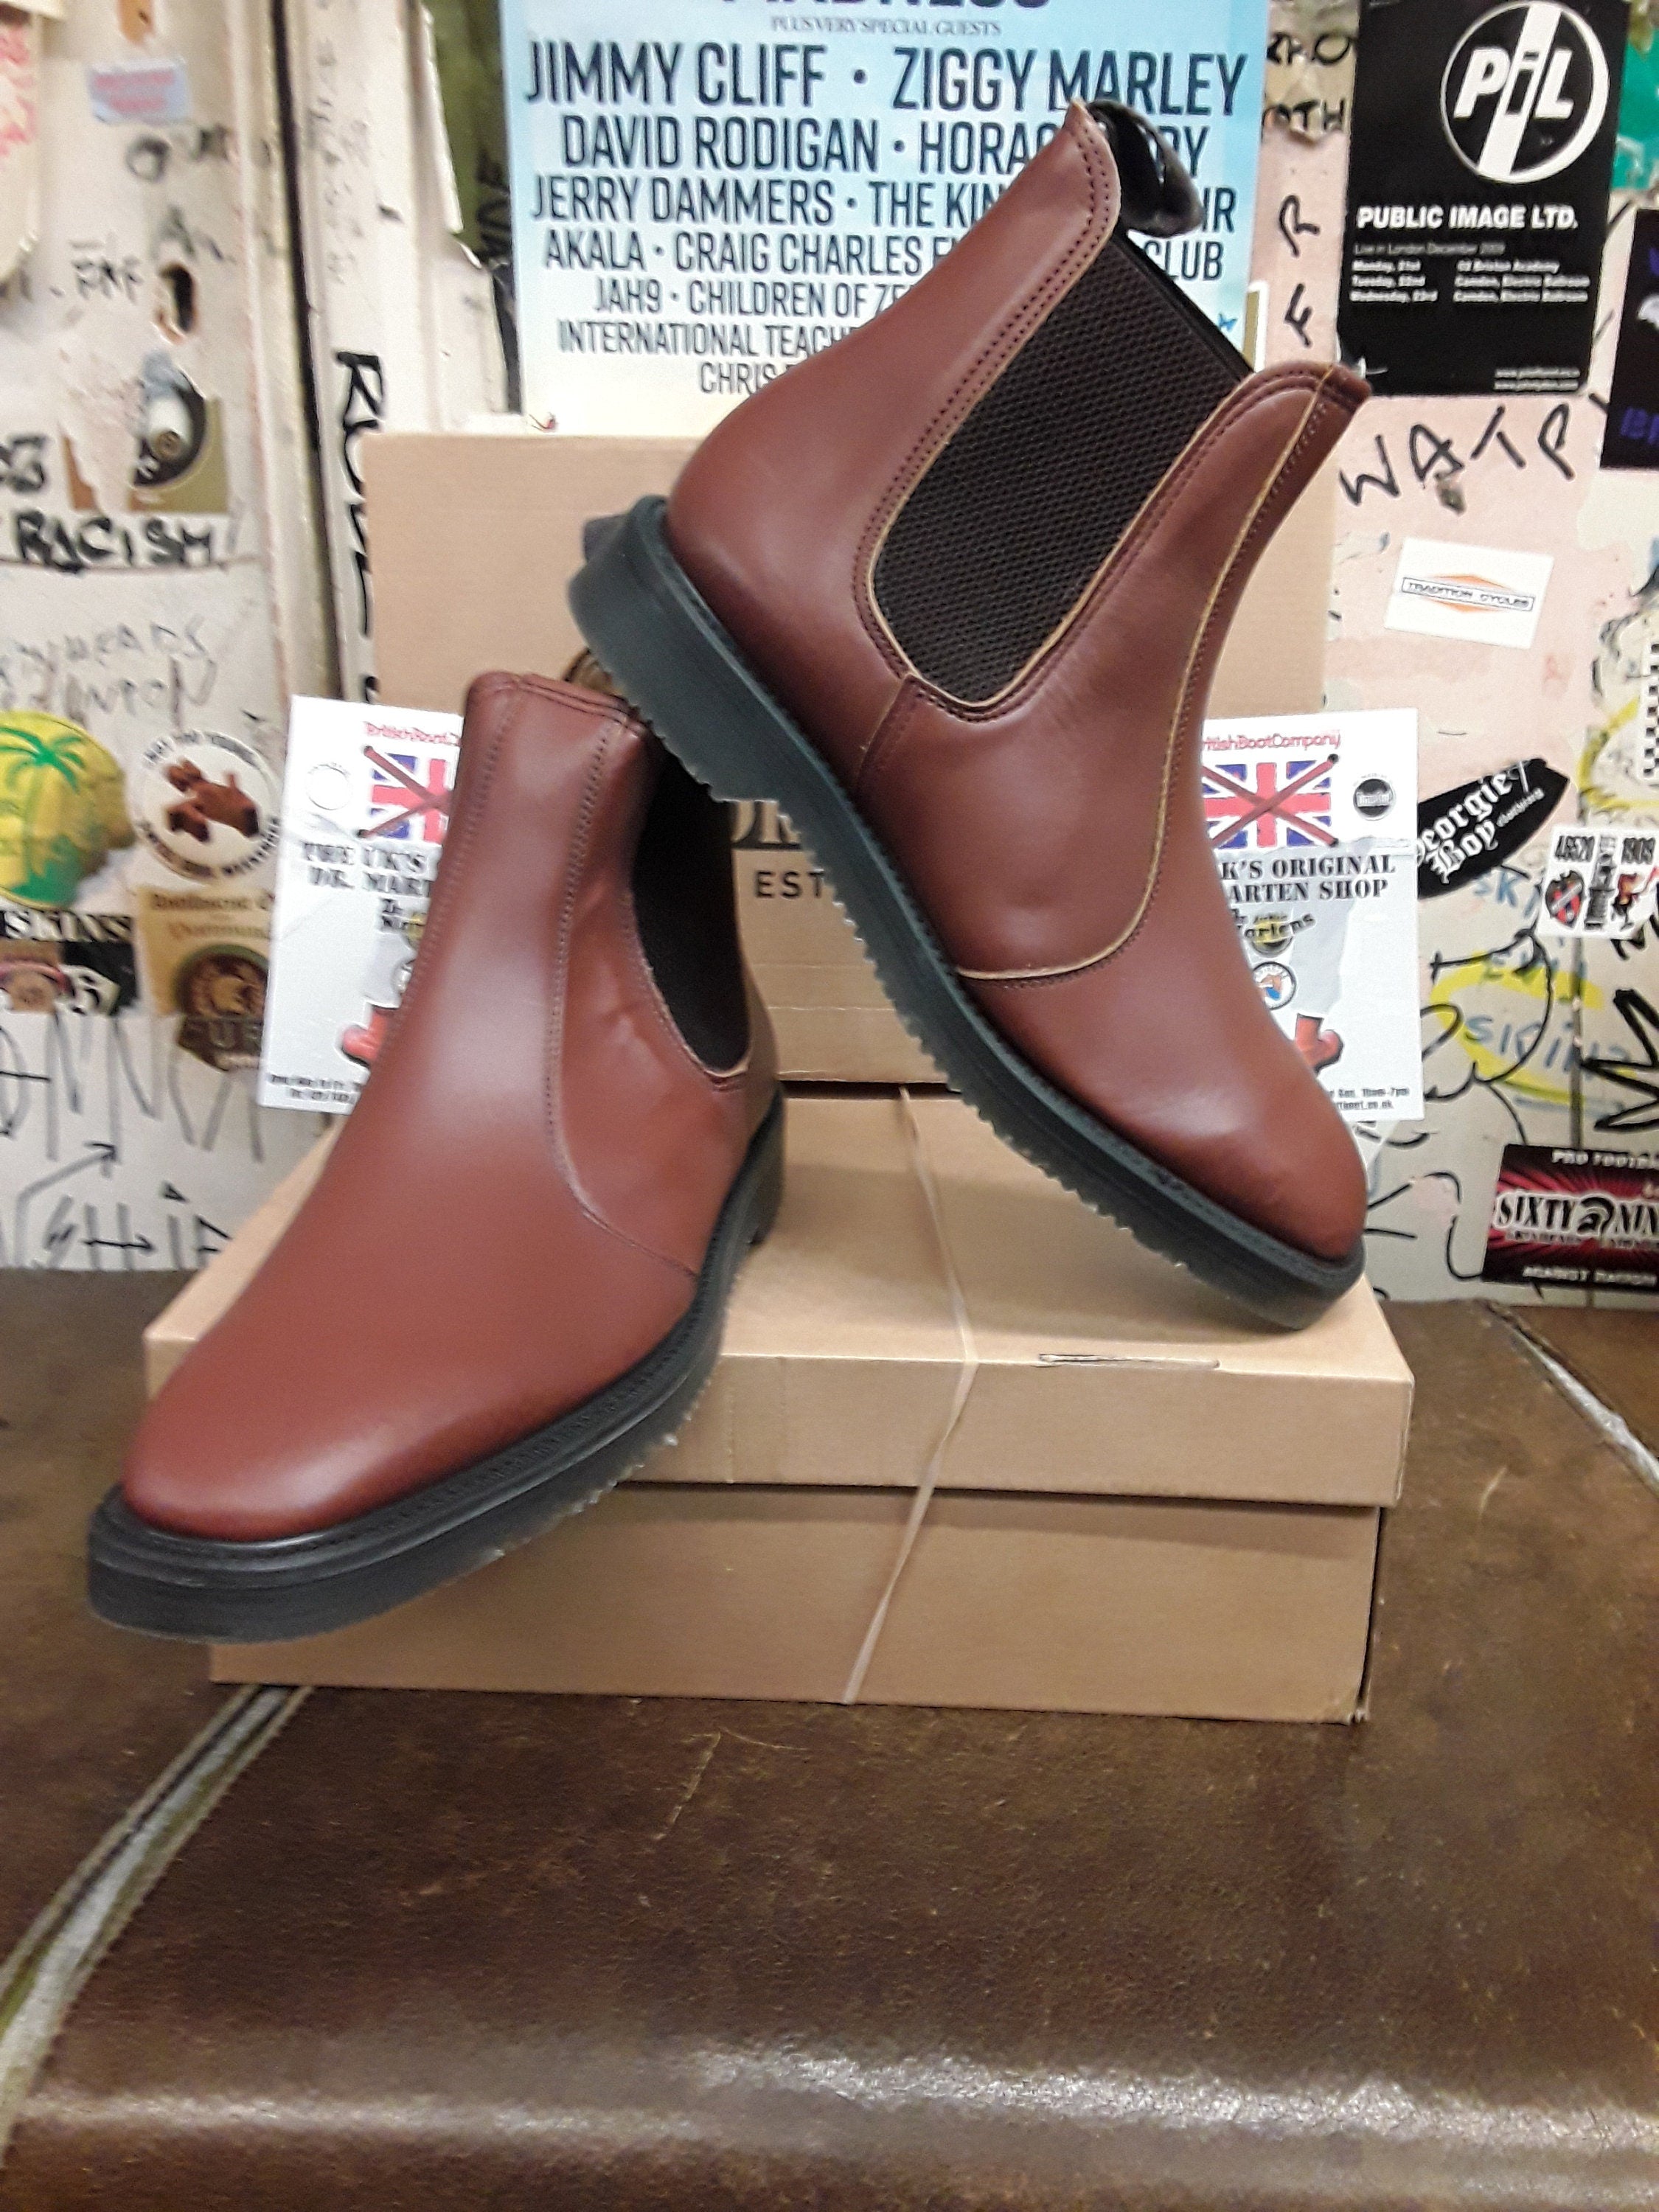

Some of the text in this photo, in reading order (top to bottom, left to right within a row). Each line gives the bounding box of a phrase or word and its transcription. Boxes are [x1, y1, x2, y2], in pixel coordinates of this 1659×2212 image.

[526, 41, 1248, 116] JIMMY CLIFF ZIGGY MARLEY
[563, 114, 680, 169] DAVID
[696, 116, 878, 172] RODIGAN
[534, 175, 1003, 229] JERRY DAMMERS THE KIN
[1357, 204, 1579, 229] PUBLIC IMAGE LTD.
[546, 229, 645, 271] AKALA
[675, 231, 770, 273] CRAIG
[780, 234, 922, 276] CHARLES
[595, 278, 661, 313] JAH9
[689, 279, 826, 318] CHILDREN
[835, 282, 868, 318] OF
[558, 319, 861, 357] INTERNATIONAL TEAC
[13, 510, 212, 574] RACISM
[1221, 854, 1397, 880] K'S ORIGINAL
[1228, 878, 1389, 904] ARTEN SHOP
[1497, 1194, 1576, 1230] SIXTY
